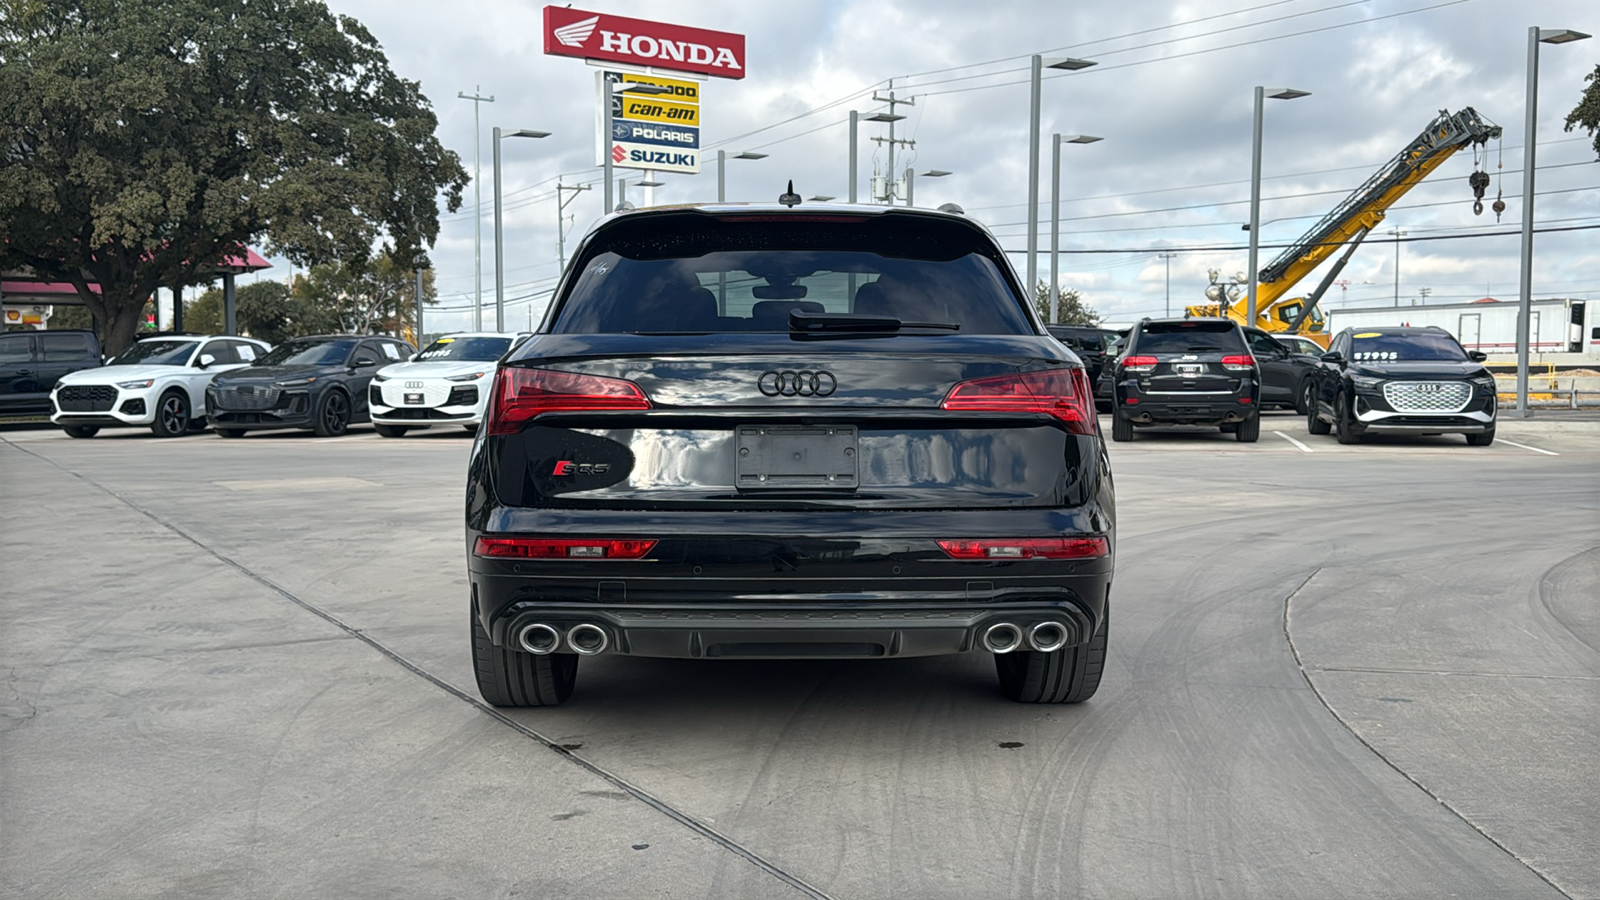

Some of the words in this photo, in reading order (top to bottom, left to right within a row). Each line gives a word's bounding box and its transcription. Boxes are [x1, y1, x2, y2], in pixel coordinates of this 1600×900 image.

[599, 30, 742, 69] HONDA
[629, 103, 695, 120] can-am
[633, 128, 694, 143] POLARIS
[630, 149, 694, 166] SUZUKI
[560, 462, 610, 475] SQ5
